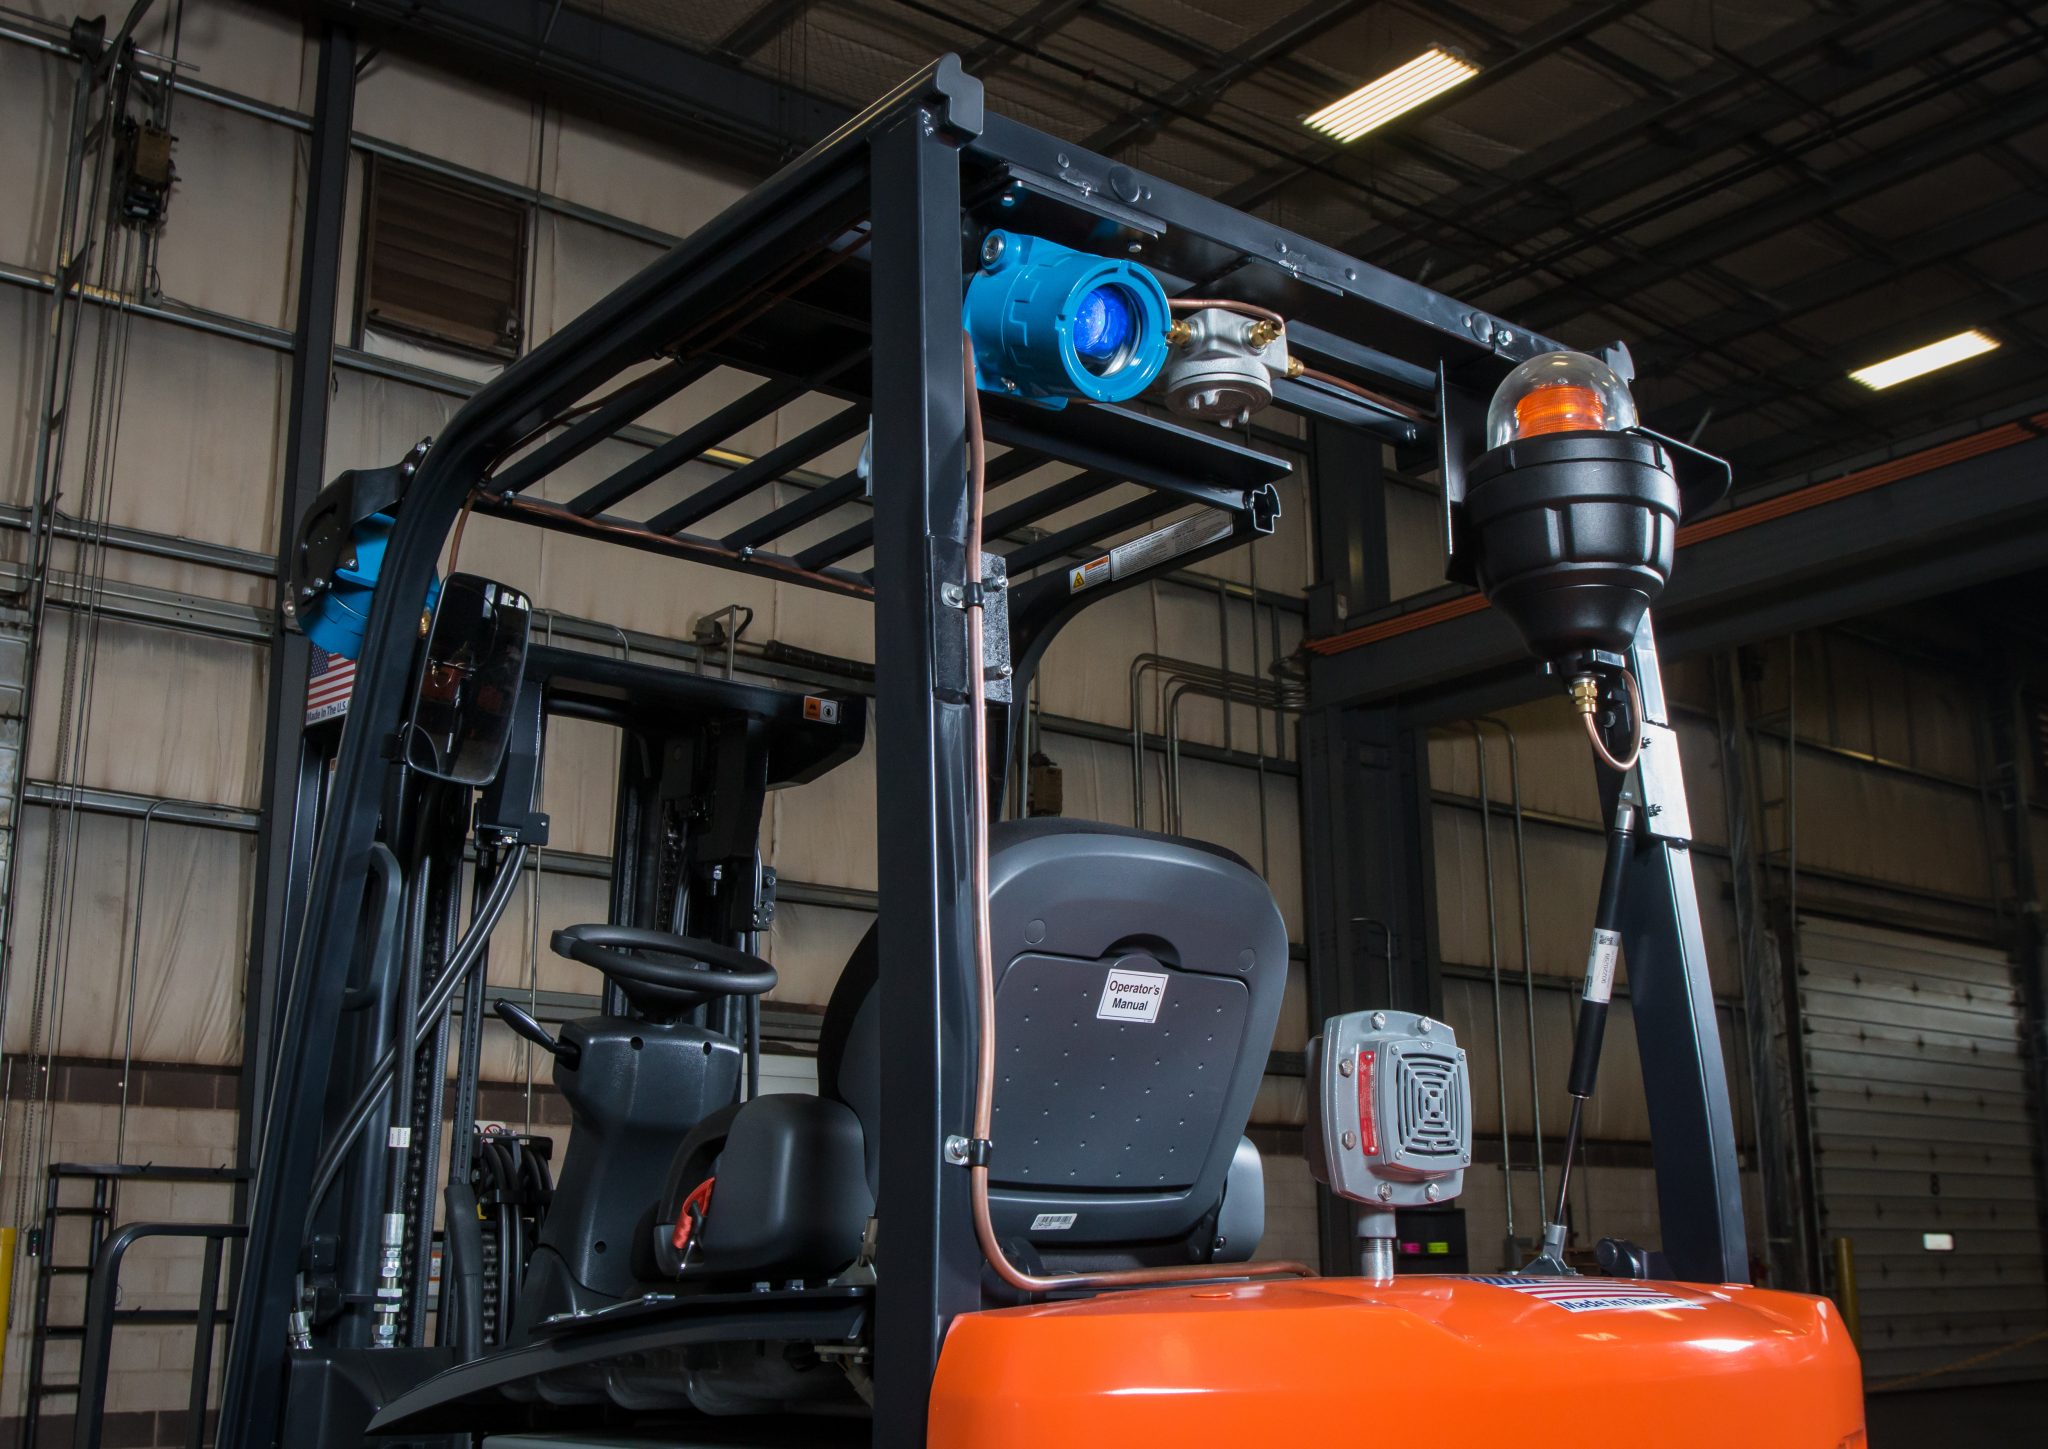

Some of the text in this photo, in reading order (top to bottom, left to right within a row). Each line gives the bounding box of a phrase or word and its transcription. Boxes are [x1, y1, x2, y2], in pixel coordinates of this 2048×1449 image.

[327, 705, 336, 715] The
[1109, 980, 1160, 996] Operator's
[1112, 997, 1148, 1011] Manual
[1556, 1299, 1609, 1309] Made
